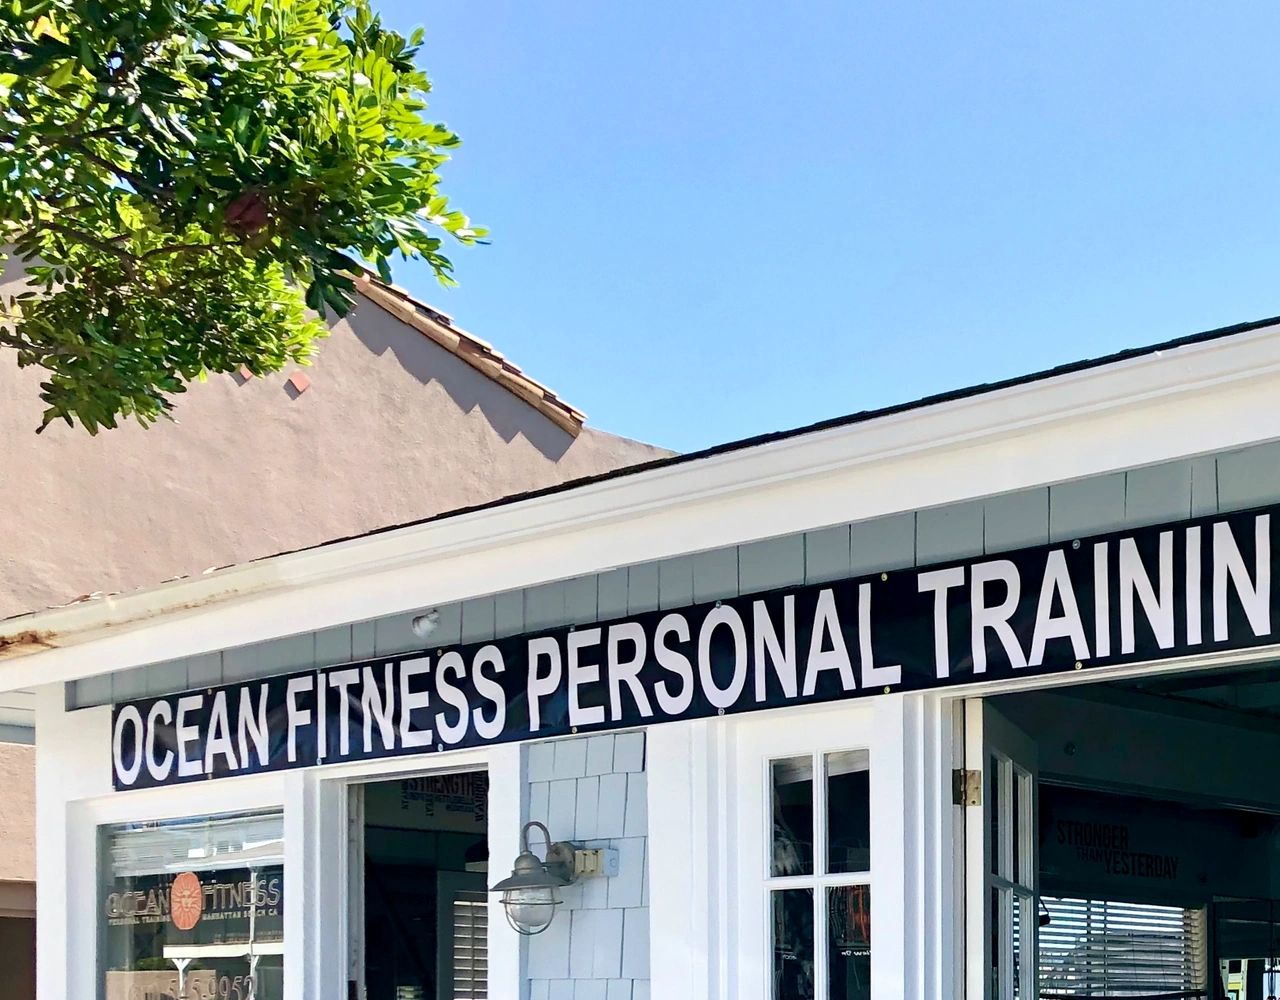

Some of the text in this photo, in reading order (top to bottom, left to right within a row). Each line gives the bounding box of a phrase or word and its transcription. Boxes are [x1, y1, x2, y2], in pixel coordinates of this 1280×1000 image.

[113, 682, 270, 786] OCEAN
[286, 644, 507, 763] FITNESS
[527, 582, 902, 732] PERSONAL
[1056, 818, 1129, 852] STRONGER
[1103, 849, 1179, 881] YESTERDAY
[105, 878, 282, 918] OCEAN FITNESS
